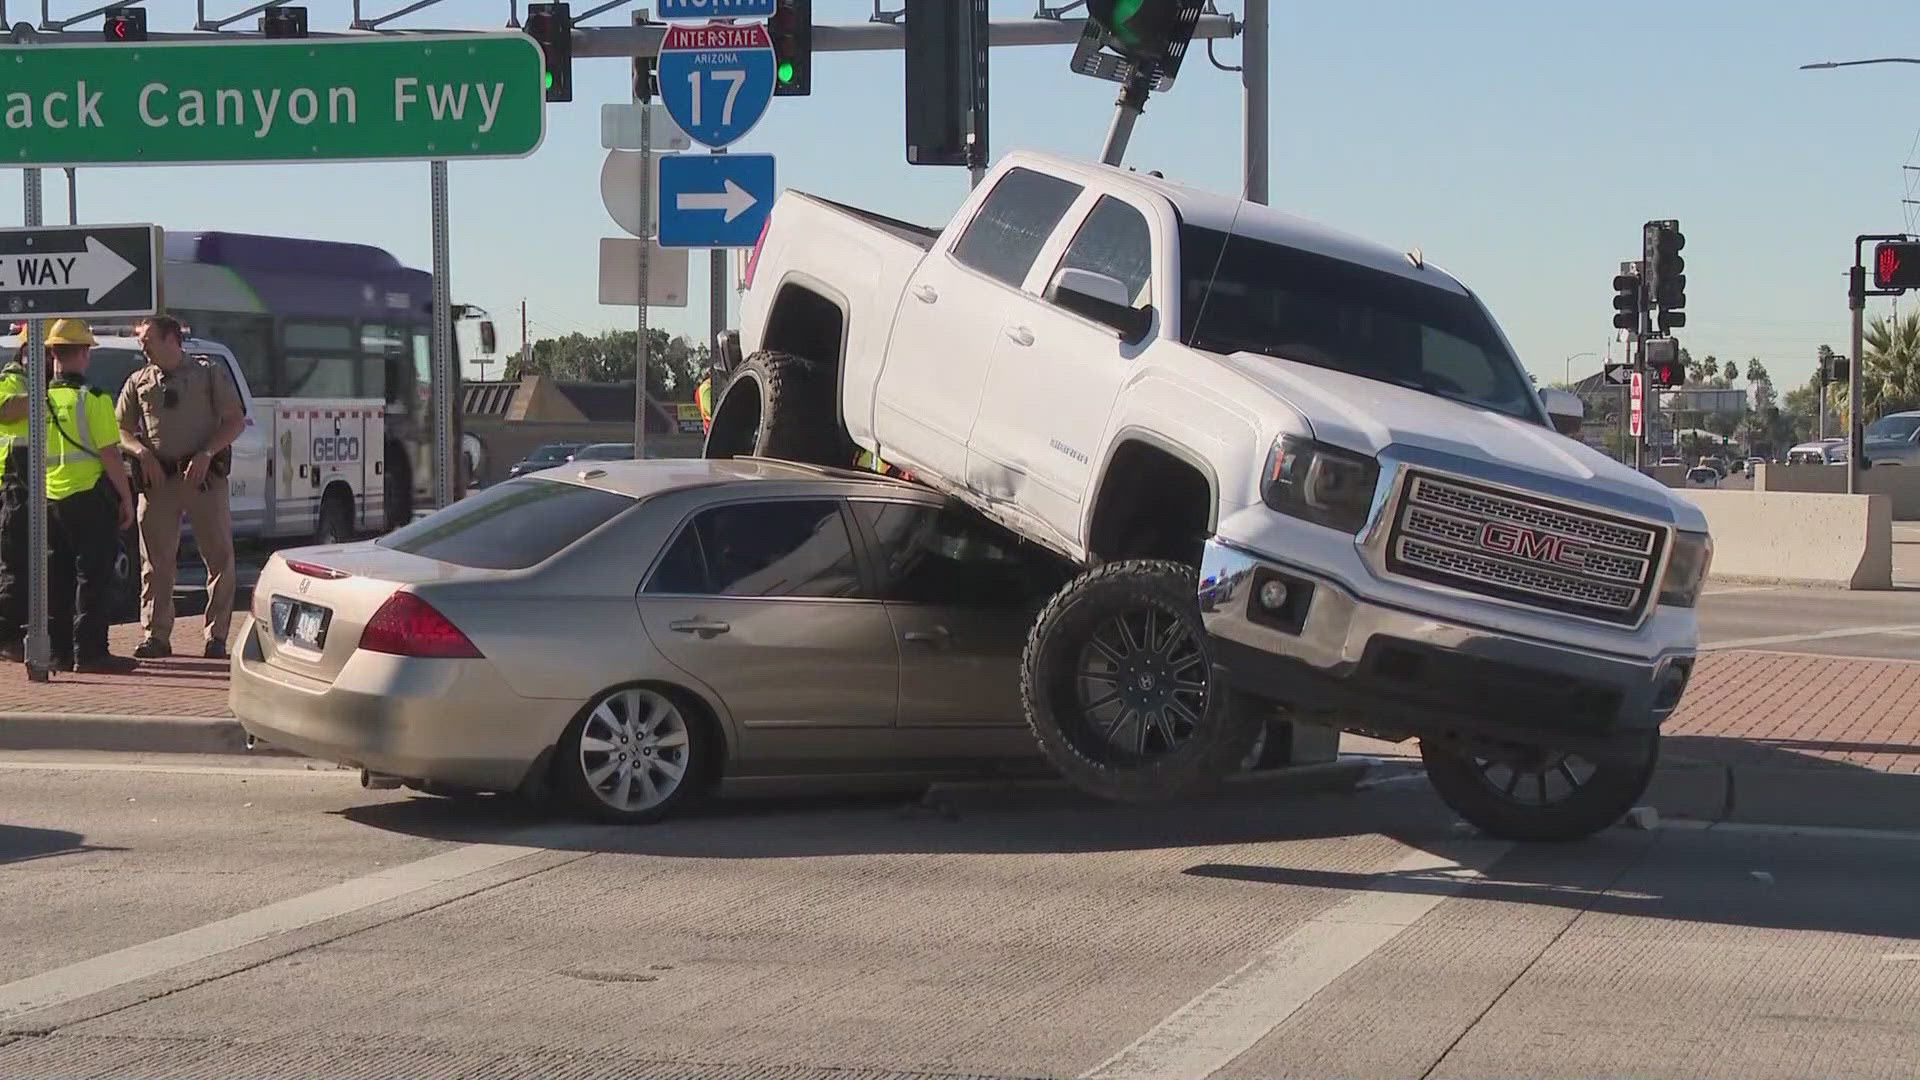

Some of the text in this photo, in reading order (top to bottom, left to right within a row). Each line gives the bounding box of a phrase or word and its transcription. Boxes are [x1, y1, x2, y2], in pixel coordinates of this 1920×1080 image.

[673, 30, 759, 48] INTERSTATE
[694, 53, 739, 65] ARIZONA
[138, 82, 358, 138] Canyon
[394, 77, 505, 133] Fwy
[687, 69, 747, 126] 17
[17, 257, 77, 286] WAY
[313, 437, 359, 461] GEICO
[1479, 522, 1591, 572] GMC
